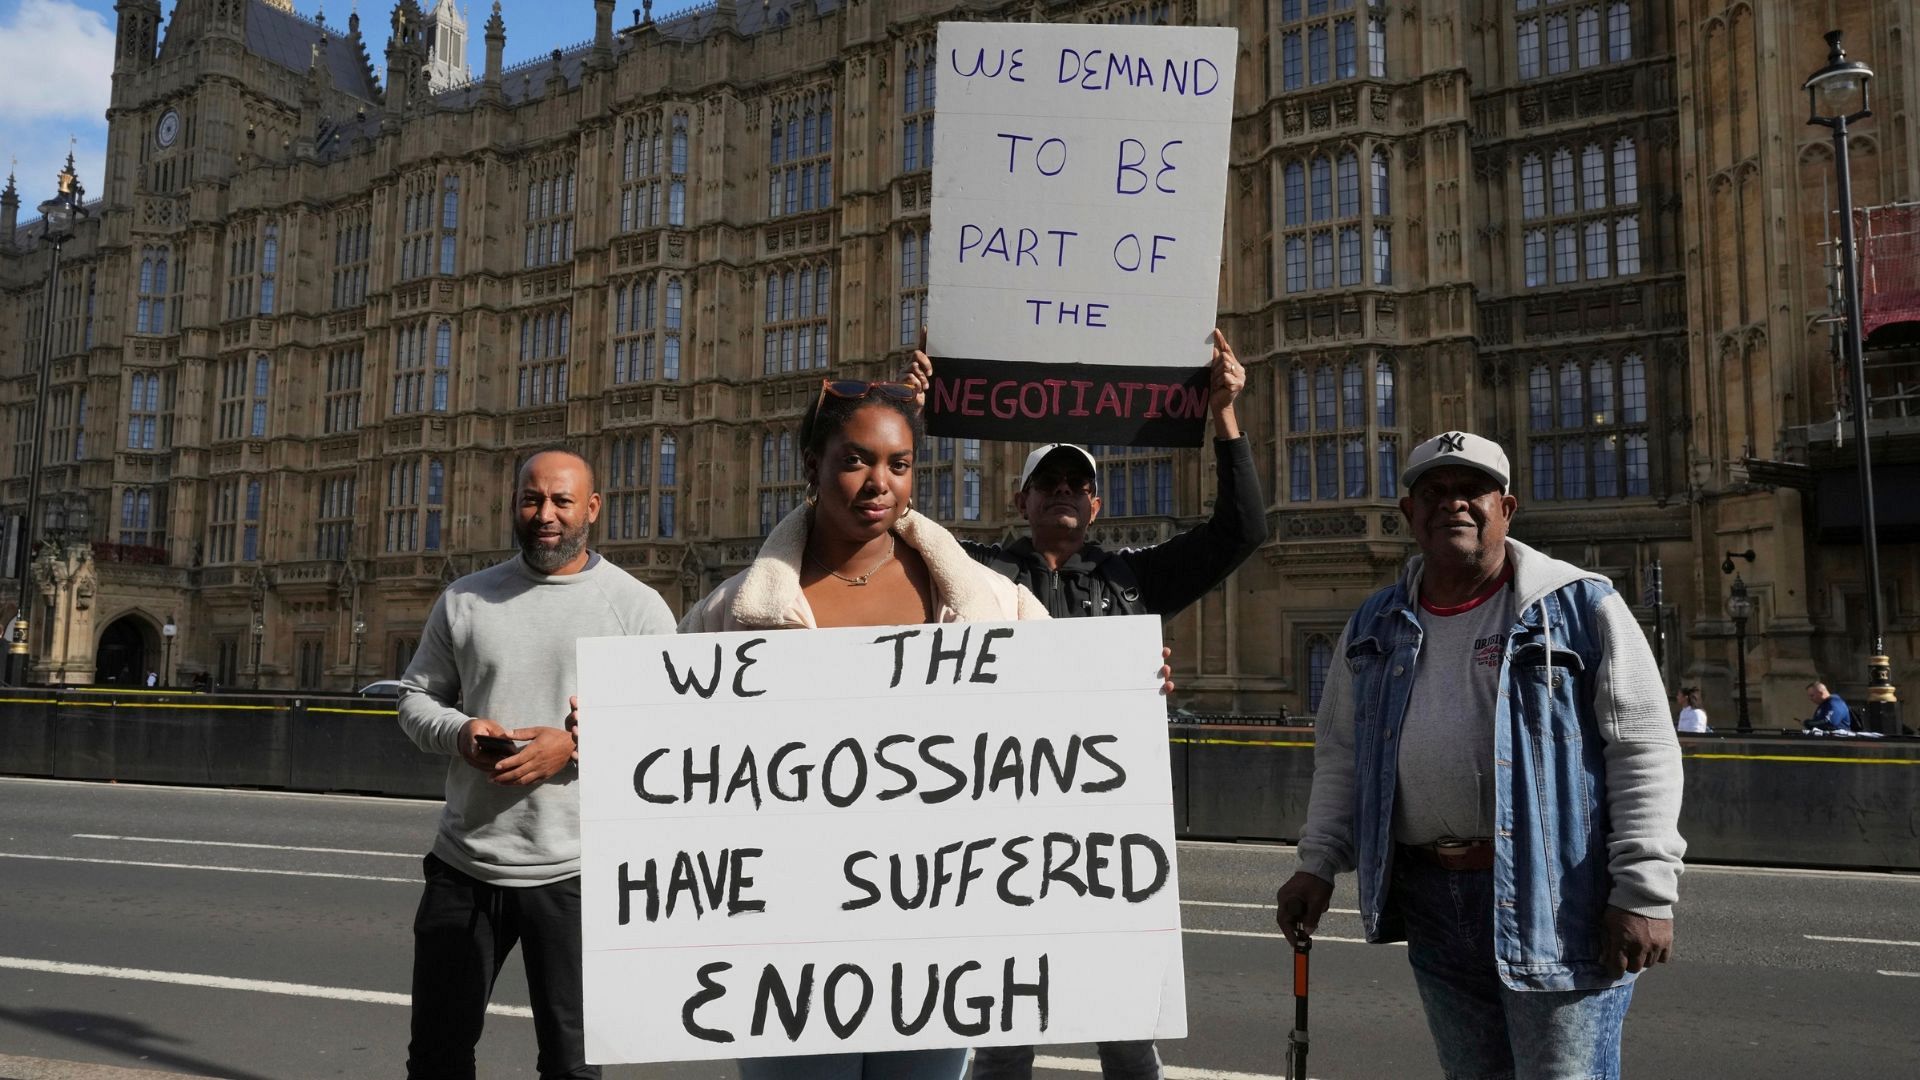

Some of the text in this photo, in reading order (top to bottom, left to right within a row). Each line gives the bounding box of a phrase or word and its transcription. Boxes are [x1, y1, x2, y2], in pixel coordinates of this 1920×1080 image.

[952, 47, 1219, 97] WE DEMAND
[996, 133, 1183, 195] TO BE
[958, 223, 1177, 274] PART OF
[1026, 299, 1110, 328] THE
[933, 376, 1209, 421] NEGOTIATION
[1437, 432, 1466, 452] NY
[662, 627, 1014, 699] WE THE
[633, 732, 1127, 811] CHAGOSSIANS
[618, 832, 1171, 925] HAVE SUFFERED
[682, 953, 1050, 1043] ENOUGH
